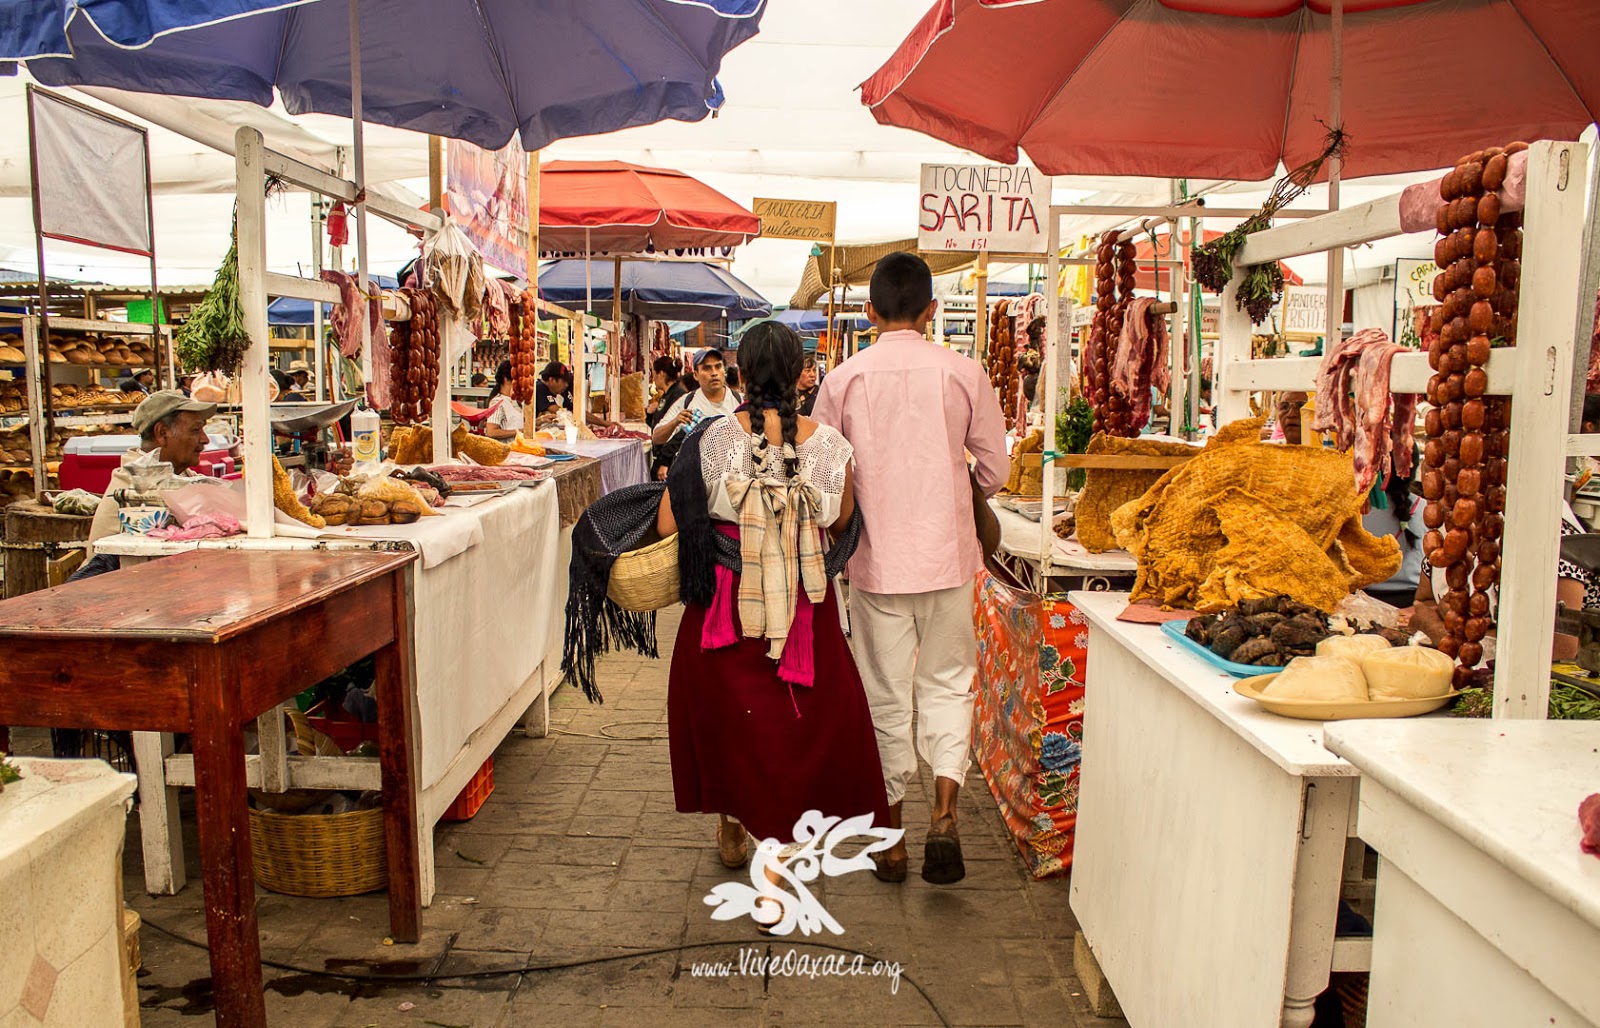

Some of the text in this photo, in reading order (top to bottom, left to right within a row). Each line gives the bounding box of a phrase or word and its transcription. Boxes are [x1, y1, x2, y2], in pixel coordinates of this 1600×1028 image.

[929, 166, 1033, 194] TOCINERIA
[756, 201, 826, 220] CARNICERIA
[919, 193, 1040, 234] SARITA
[971, 238, 987, 249] 151
[1418, 280, 1434, 296] EL
